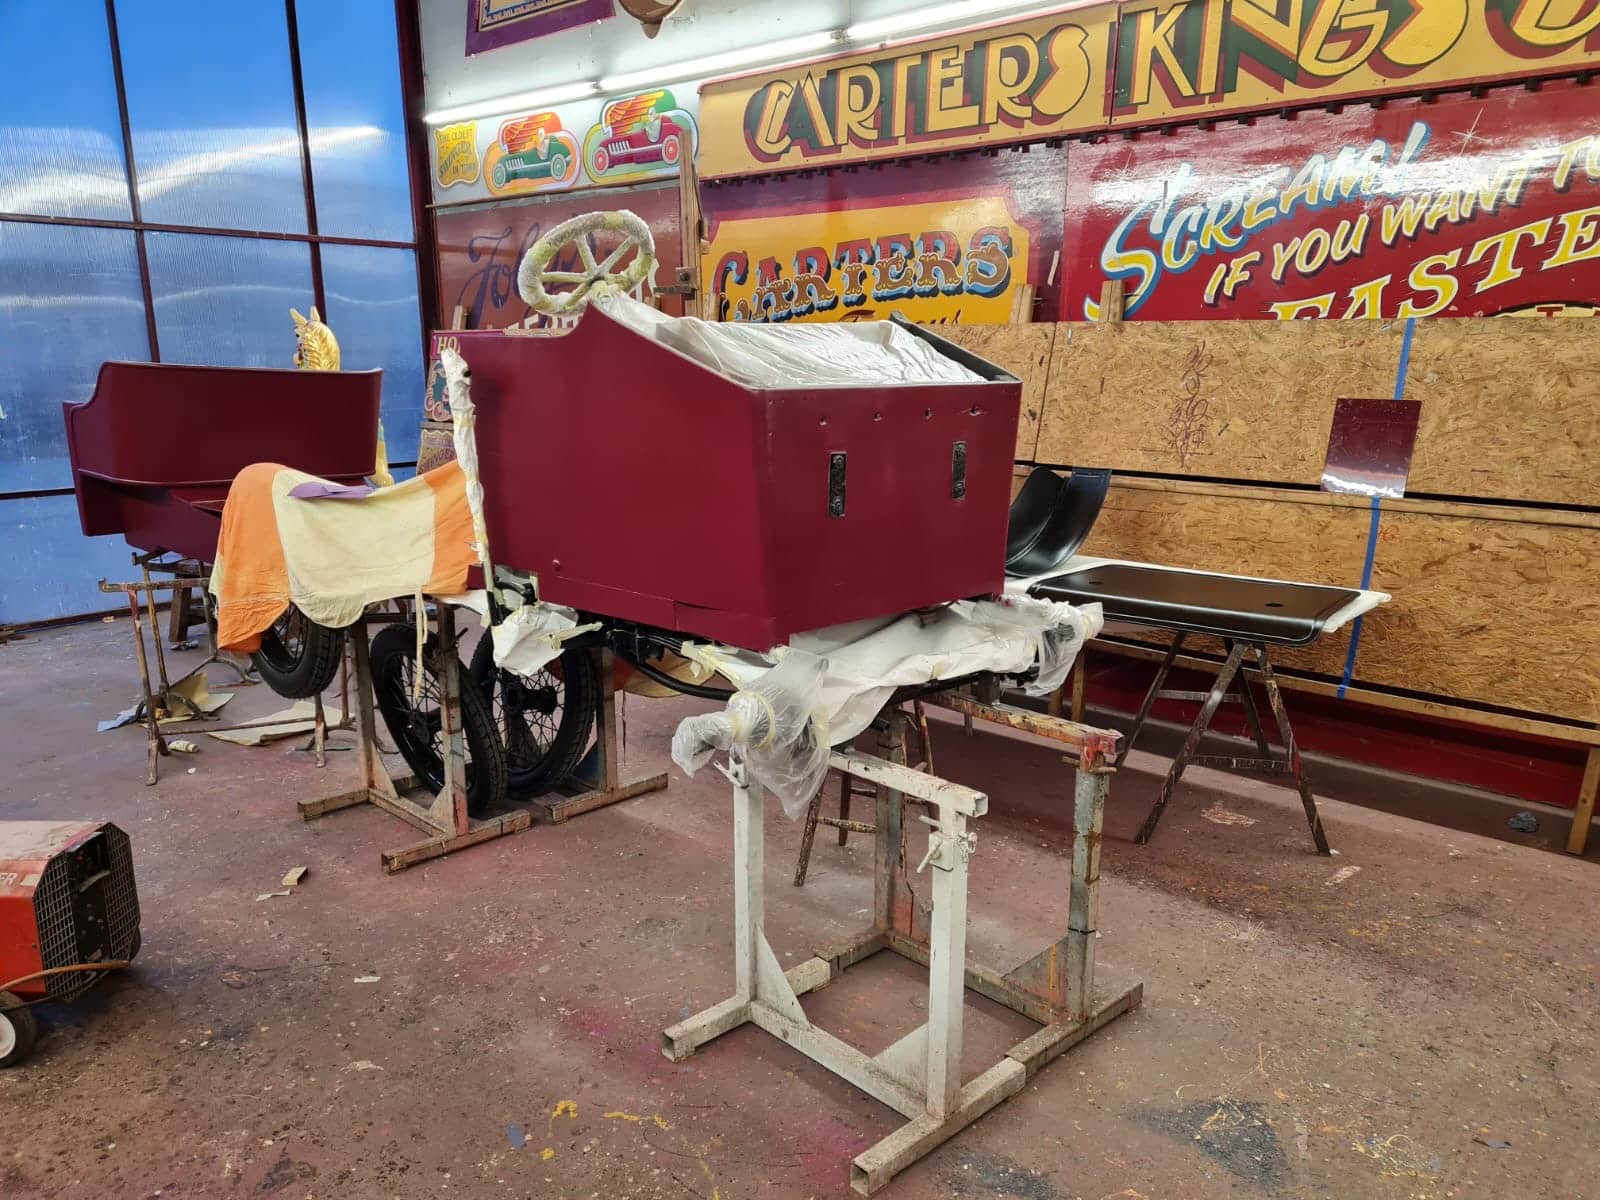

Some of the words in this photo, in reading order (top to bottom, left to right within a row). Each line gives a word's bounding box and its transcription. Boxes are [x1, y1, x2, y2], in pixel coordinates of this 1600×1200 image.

[744, 22, 1091, 163] CARTERS
[713, 226, 1014, 322] CARTERS
[1203, 250, 1263, 308] IF
[1271, 212, 1371, 286] YOU
[1380, 160, 1532, 246] WANT
